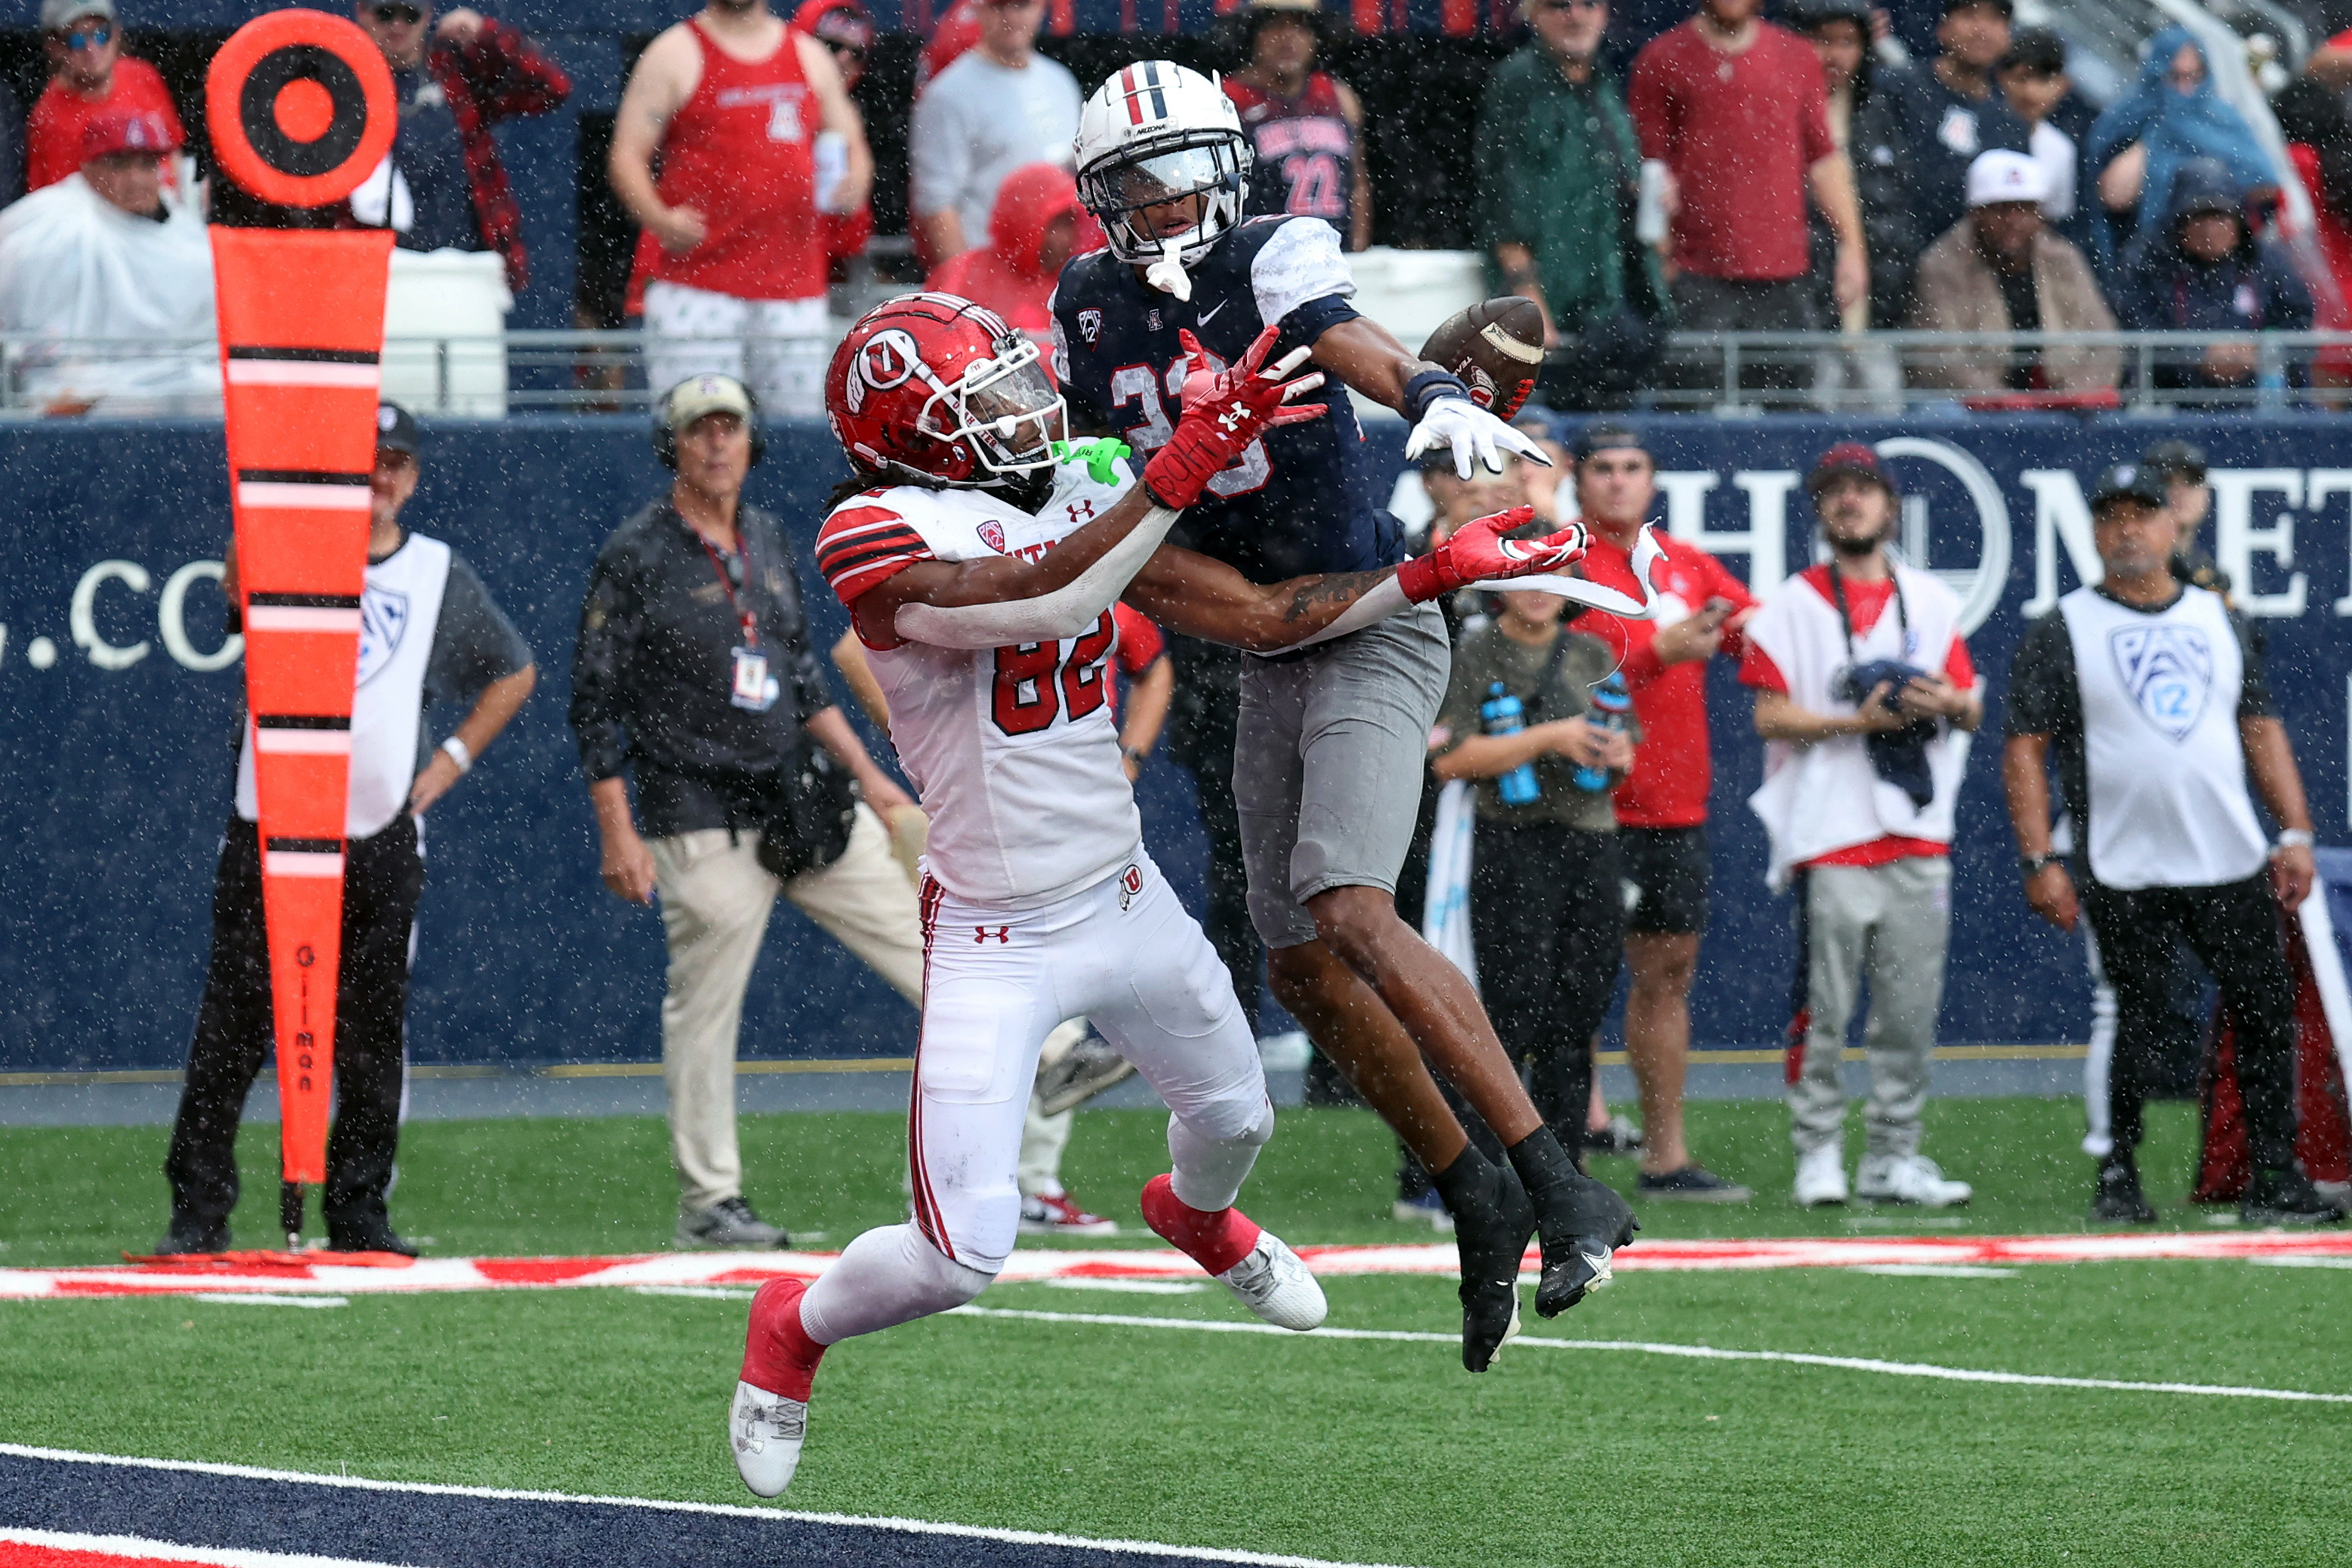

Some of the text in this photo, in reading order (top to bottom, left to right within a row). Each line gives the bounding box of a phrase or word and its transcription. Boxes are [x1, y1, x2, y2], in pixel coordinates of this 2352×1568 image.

[1136, 124, 1165, 136] ARIZONA
[1282, 152, 1346, 218] 22
[1078, 309, 1102, 335] PAC
[1085, 326, 1097, 343] 12
[952, 400, 975, 425] UAH
[977, 520, 1004, 543] PAC
[989, 534, 1004, 548] 12
[991, 607, 1114, 737] 82
[2153, 683, 2191, 717] 12
